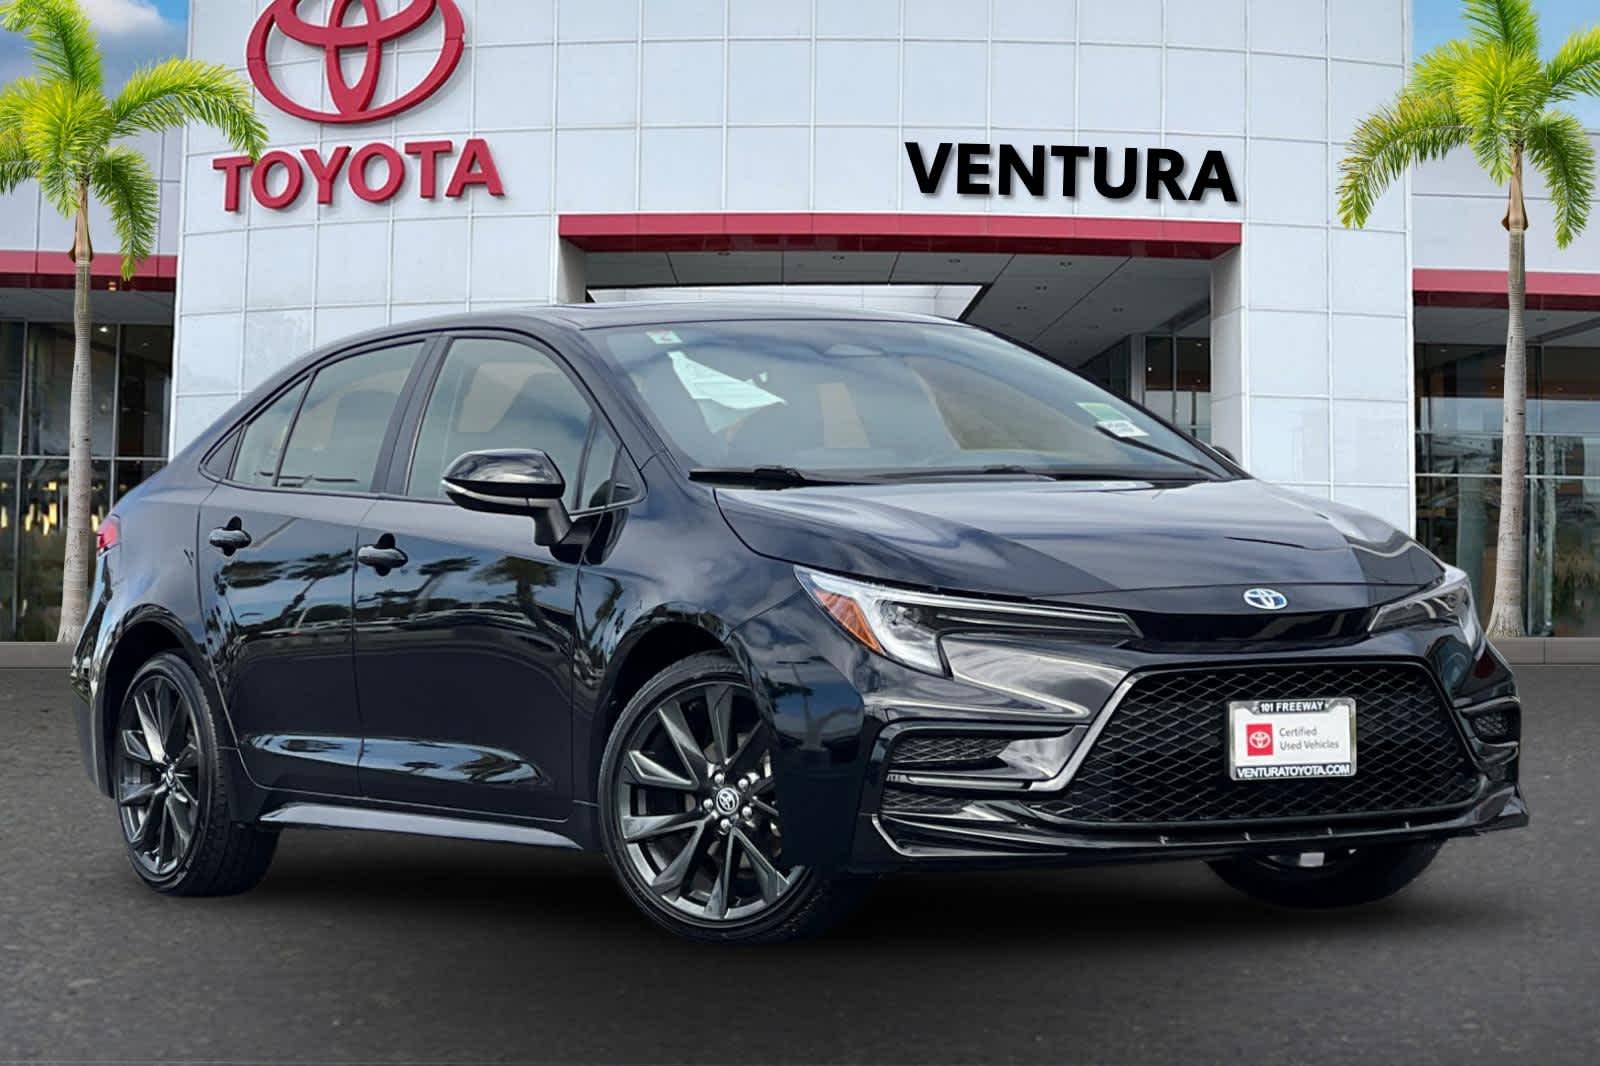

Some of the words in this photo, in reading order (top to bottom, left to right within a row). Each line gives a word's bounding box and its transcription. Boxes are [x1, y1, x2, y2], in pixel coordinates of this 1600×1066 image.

[212, 138, 505, 212] TOYOTA
[905, 142, 1238, 202] VENTURA
[1260, 703, 1273, 712] 101
[1276, 701, 1323, 712] FREEWAY
[1279, 727, 1317, 737] Certified
[1279, 742, 1302, 751] Used
[1304, 739, 1339, 750] Vehicles
[1237, 764, 1350, 778] VENTURATOYOTA.COM
